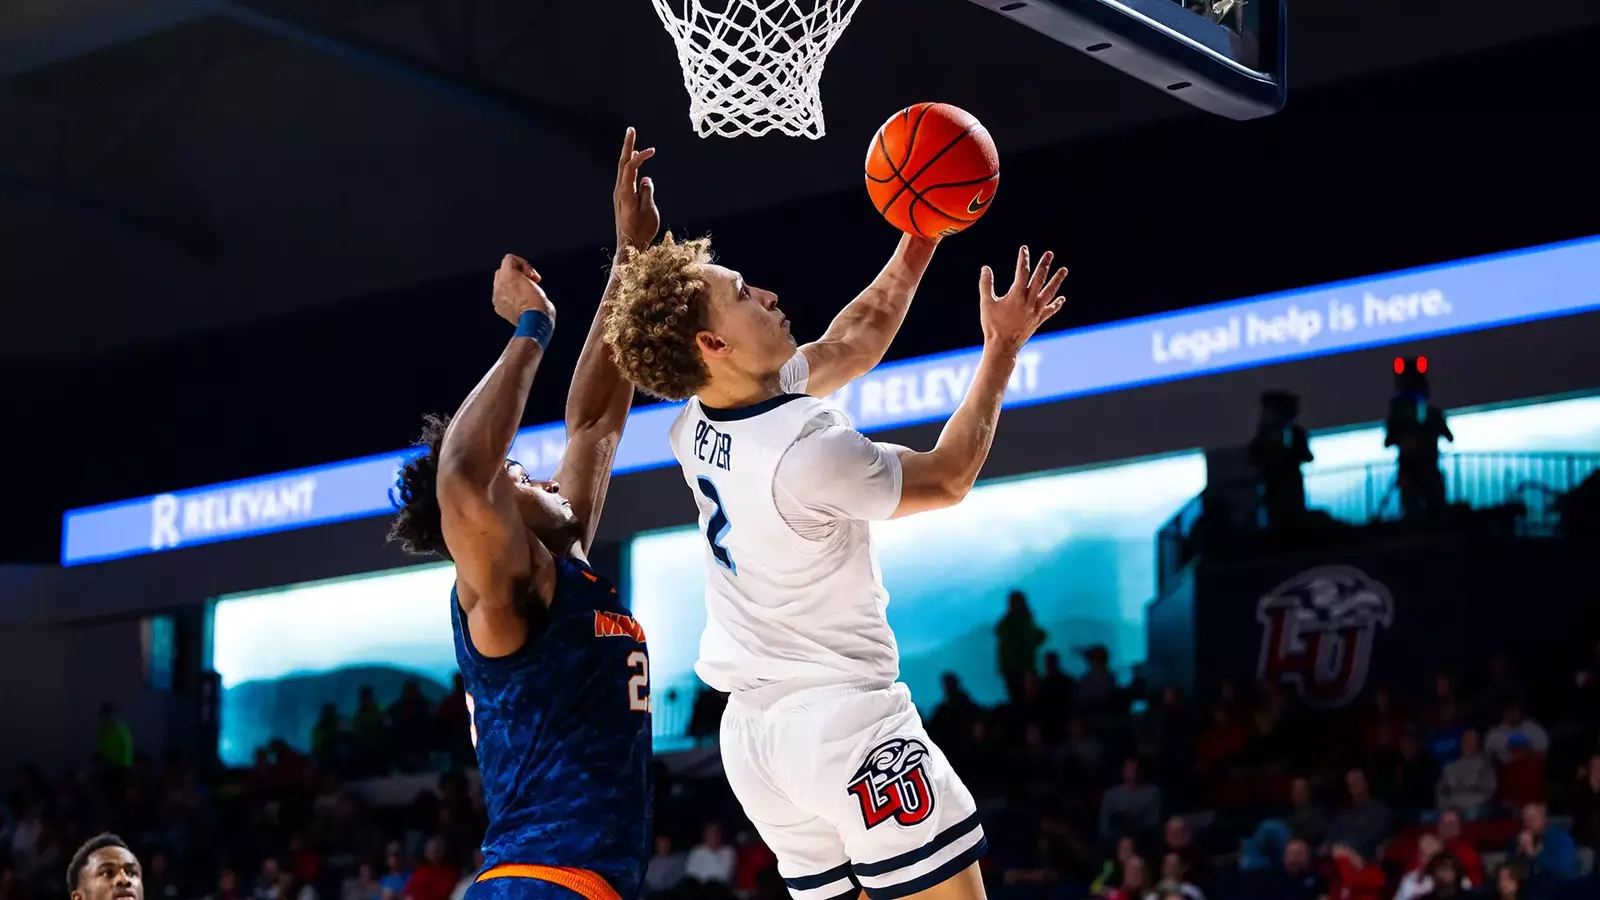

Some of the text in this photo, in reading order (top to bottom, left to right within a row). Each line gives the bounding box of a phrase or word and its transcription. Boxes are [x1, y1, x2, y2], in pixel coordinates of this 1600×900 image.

[1151, 288, 1453, 364] Legal help is here.
[861, 352, 1042, 421] RELEVT
[694, 419, 732, 471] PETER
[150, 477, 316, 548] R RELEVANT
[696, 475, 738, 577] 2
[847, 763, 935, 830] LU
